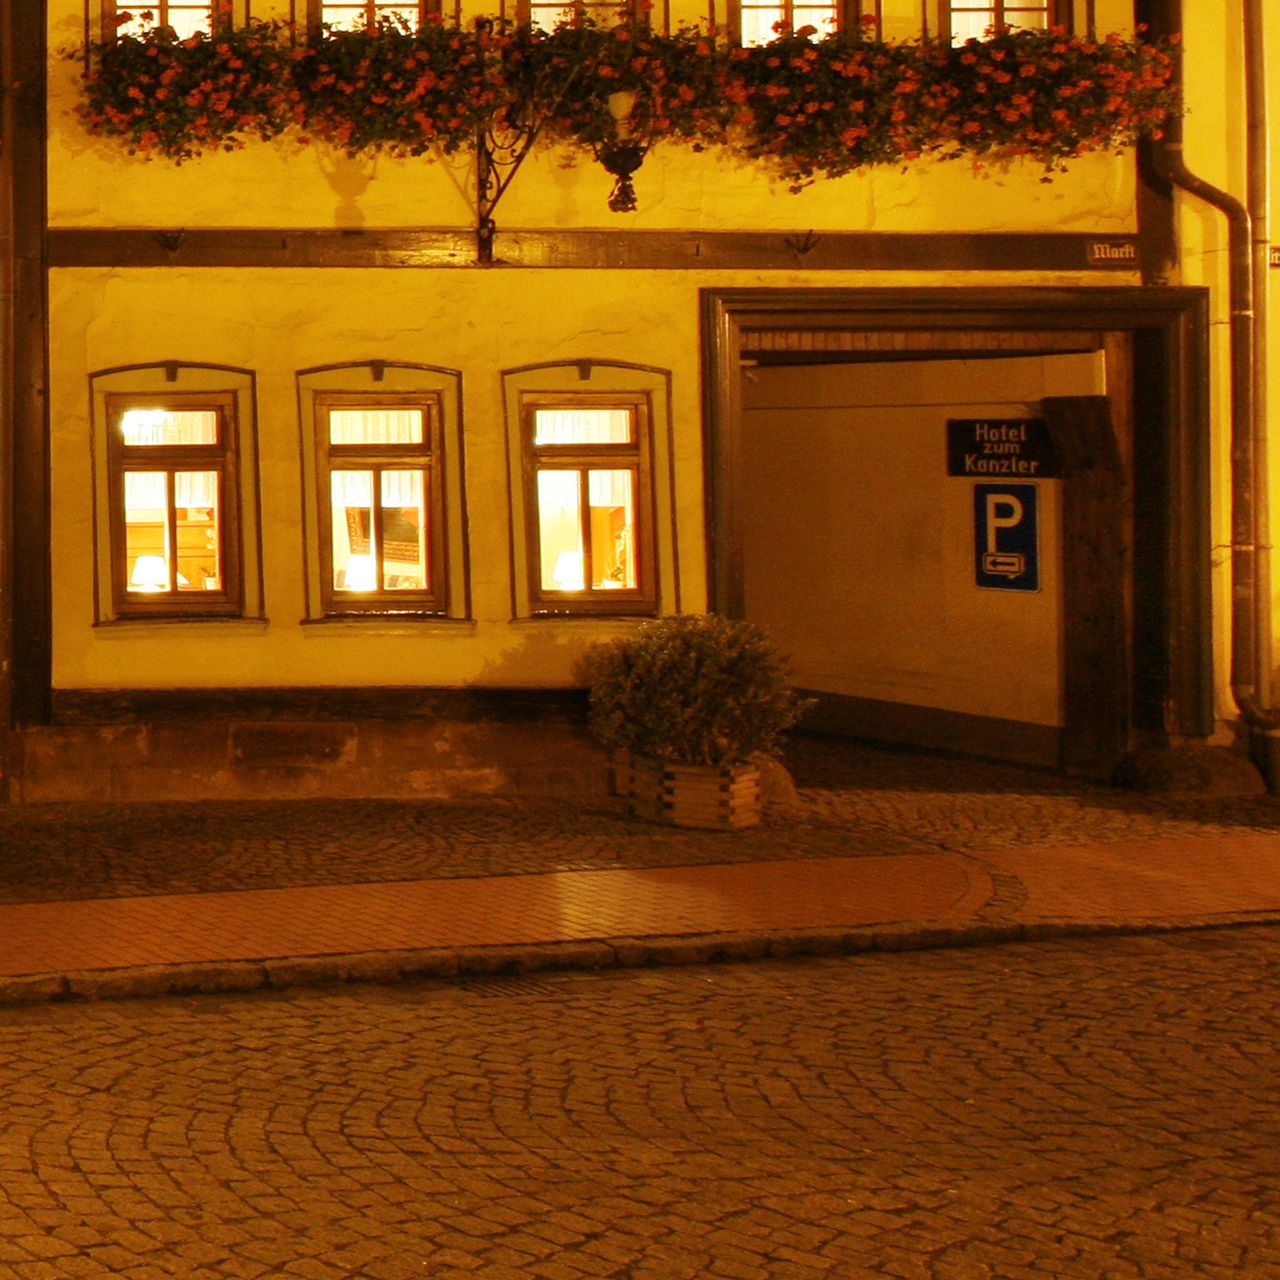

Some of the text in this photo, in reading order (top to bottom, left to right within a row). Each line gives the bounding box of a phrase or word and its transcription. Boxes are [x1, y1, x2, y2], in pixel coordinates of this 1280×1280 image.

[1093, 243, 1135, 259] Markt
[975, 423, 1027, 442] Hotel
[983, 442, 1020, 454] zum
[964, 454, 1039, 474] Kanzler
[986, 493, 1024, 553] P
